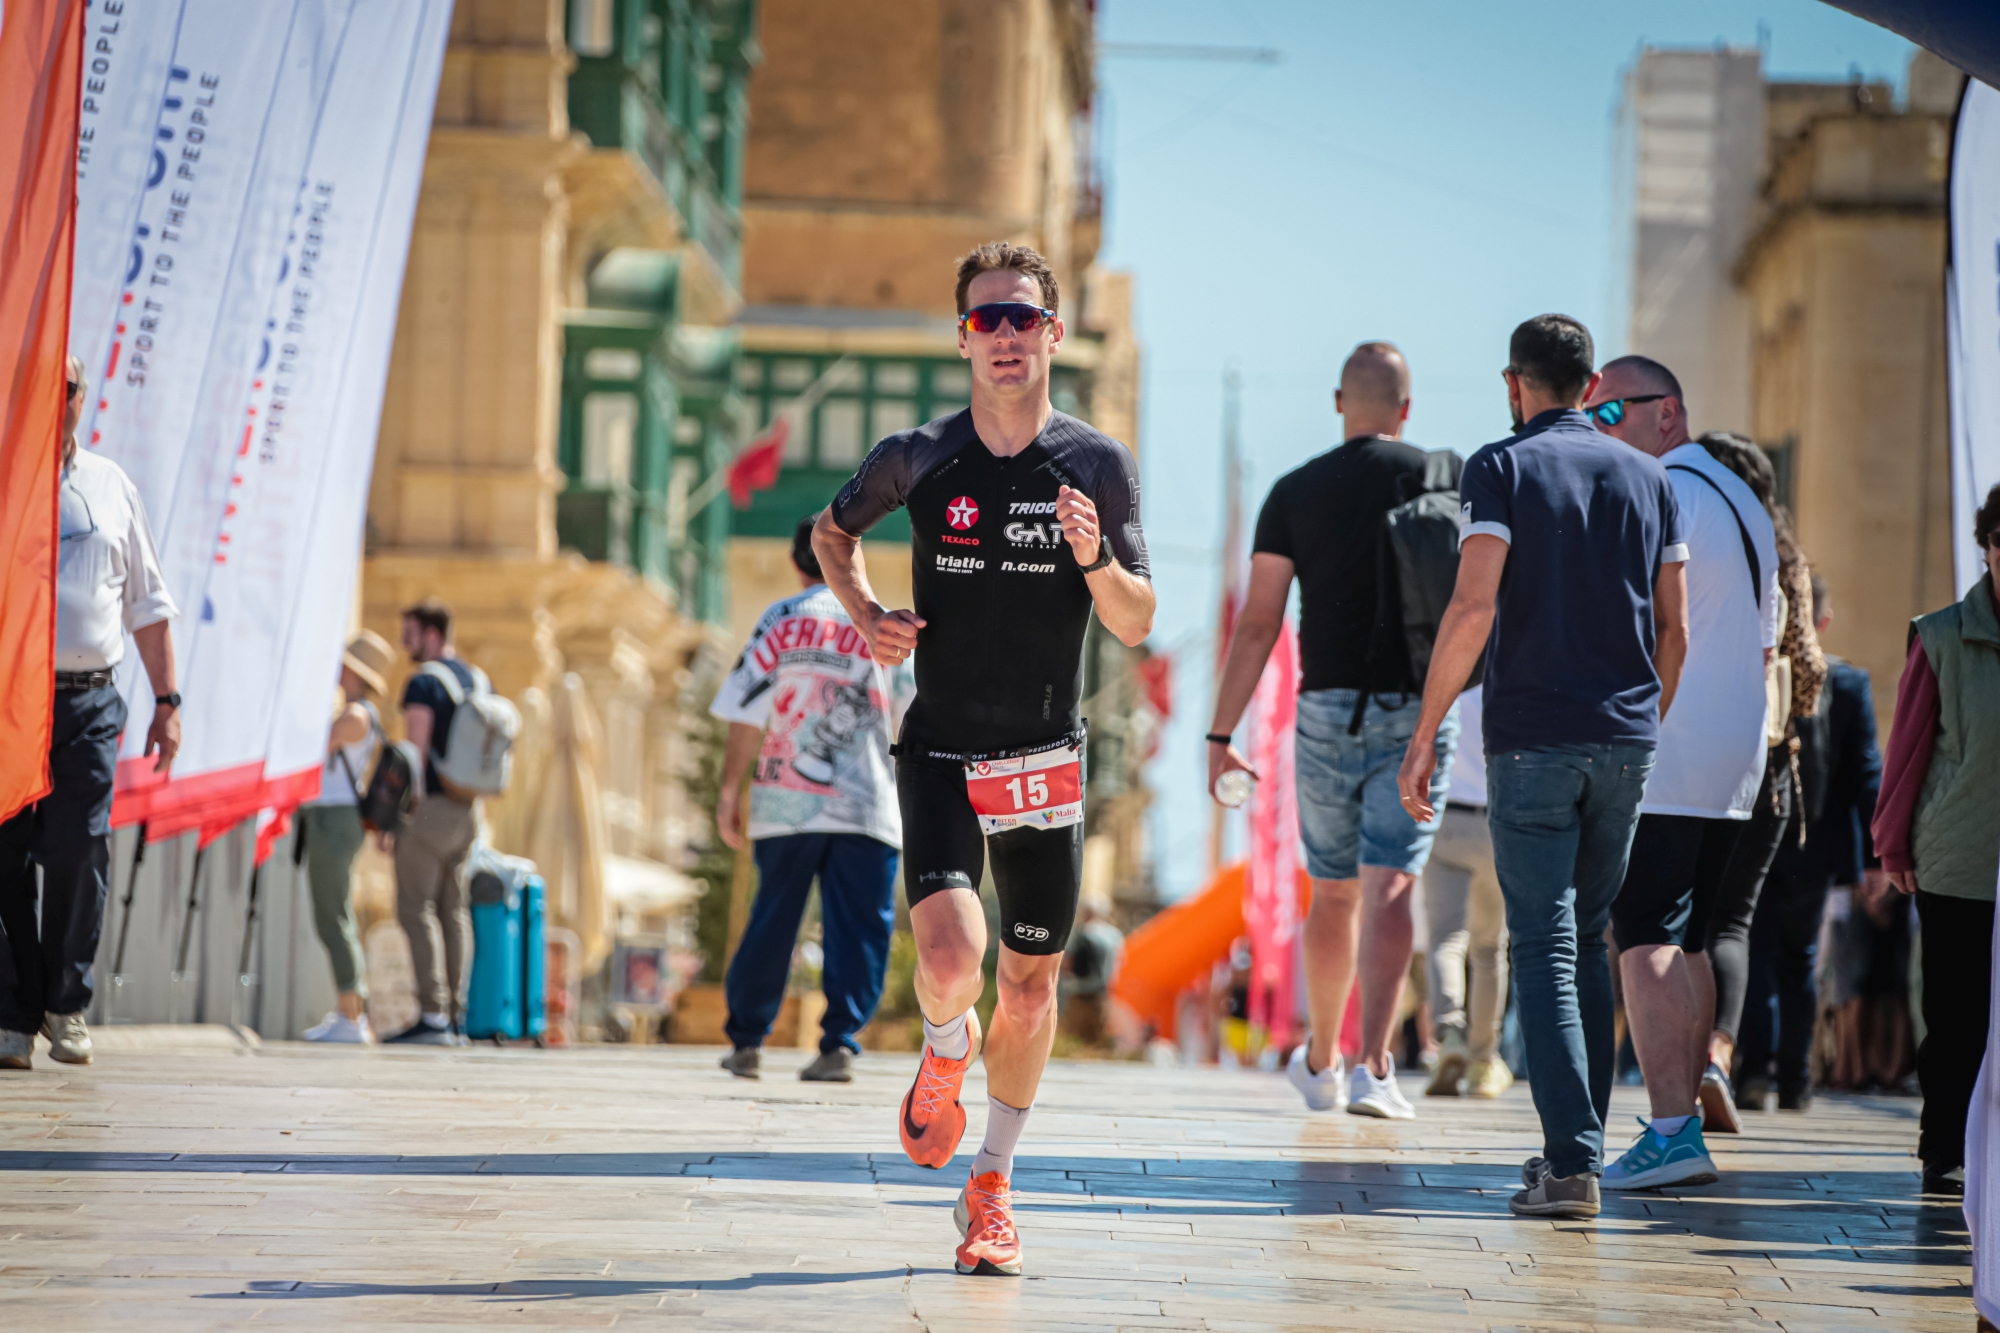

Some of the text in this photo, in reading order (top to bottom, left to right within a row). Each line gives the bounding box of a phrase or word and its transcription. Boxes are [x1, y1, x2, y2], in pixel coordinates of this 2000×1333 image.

[82, 0, 124, 114] PEOPLE
[177, 72, 220, 182] PEOPLE
[160, 188, 190, 243] THE
[150, 253, 174, 287] TO
[258, 382, 291, 465] SPORT
[277, 342, 301, 374] TO
[298, 180, 335, 279] PEOPLE
[126, 296, 163, 388] SPORT
[941, 534, 980, 546] TEXACO
[936, 554, 1056, 573] triatlo n.com
[1010, 737, 1070, 757] COPRESSPORT
[1005, 773, 1049, 810] 15
[1055, 808, 1076, 818] Malta
